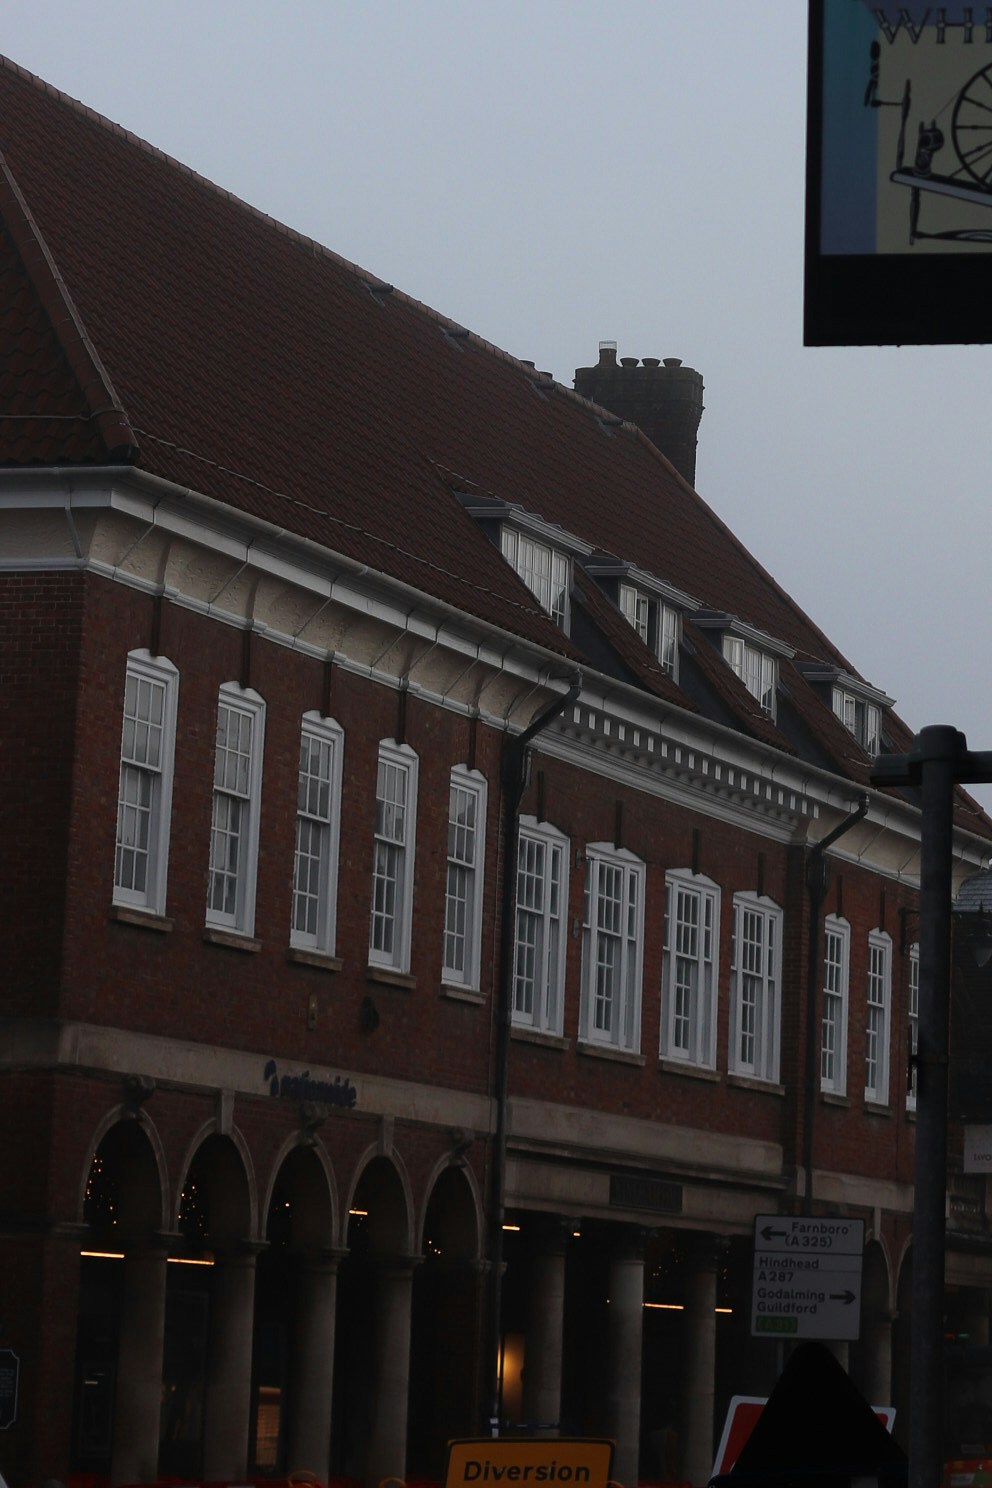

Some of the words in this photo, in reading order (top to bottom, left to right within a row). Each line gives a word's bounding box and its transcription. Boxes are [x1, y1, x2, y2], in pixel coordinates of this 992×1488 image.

[791, 1221, 852, 1235] Farnboro'
[759, 1256, 820, 1269] Hindhead
[757, 1287, 826, 1303] Godalming
[756, 1301, 818, 1314] Guildford
[463, 1460, 591, 1482] Diversion
